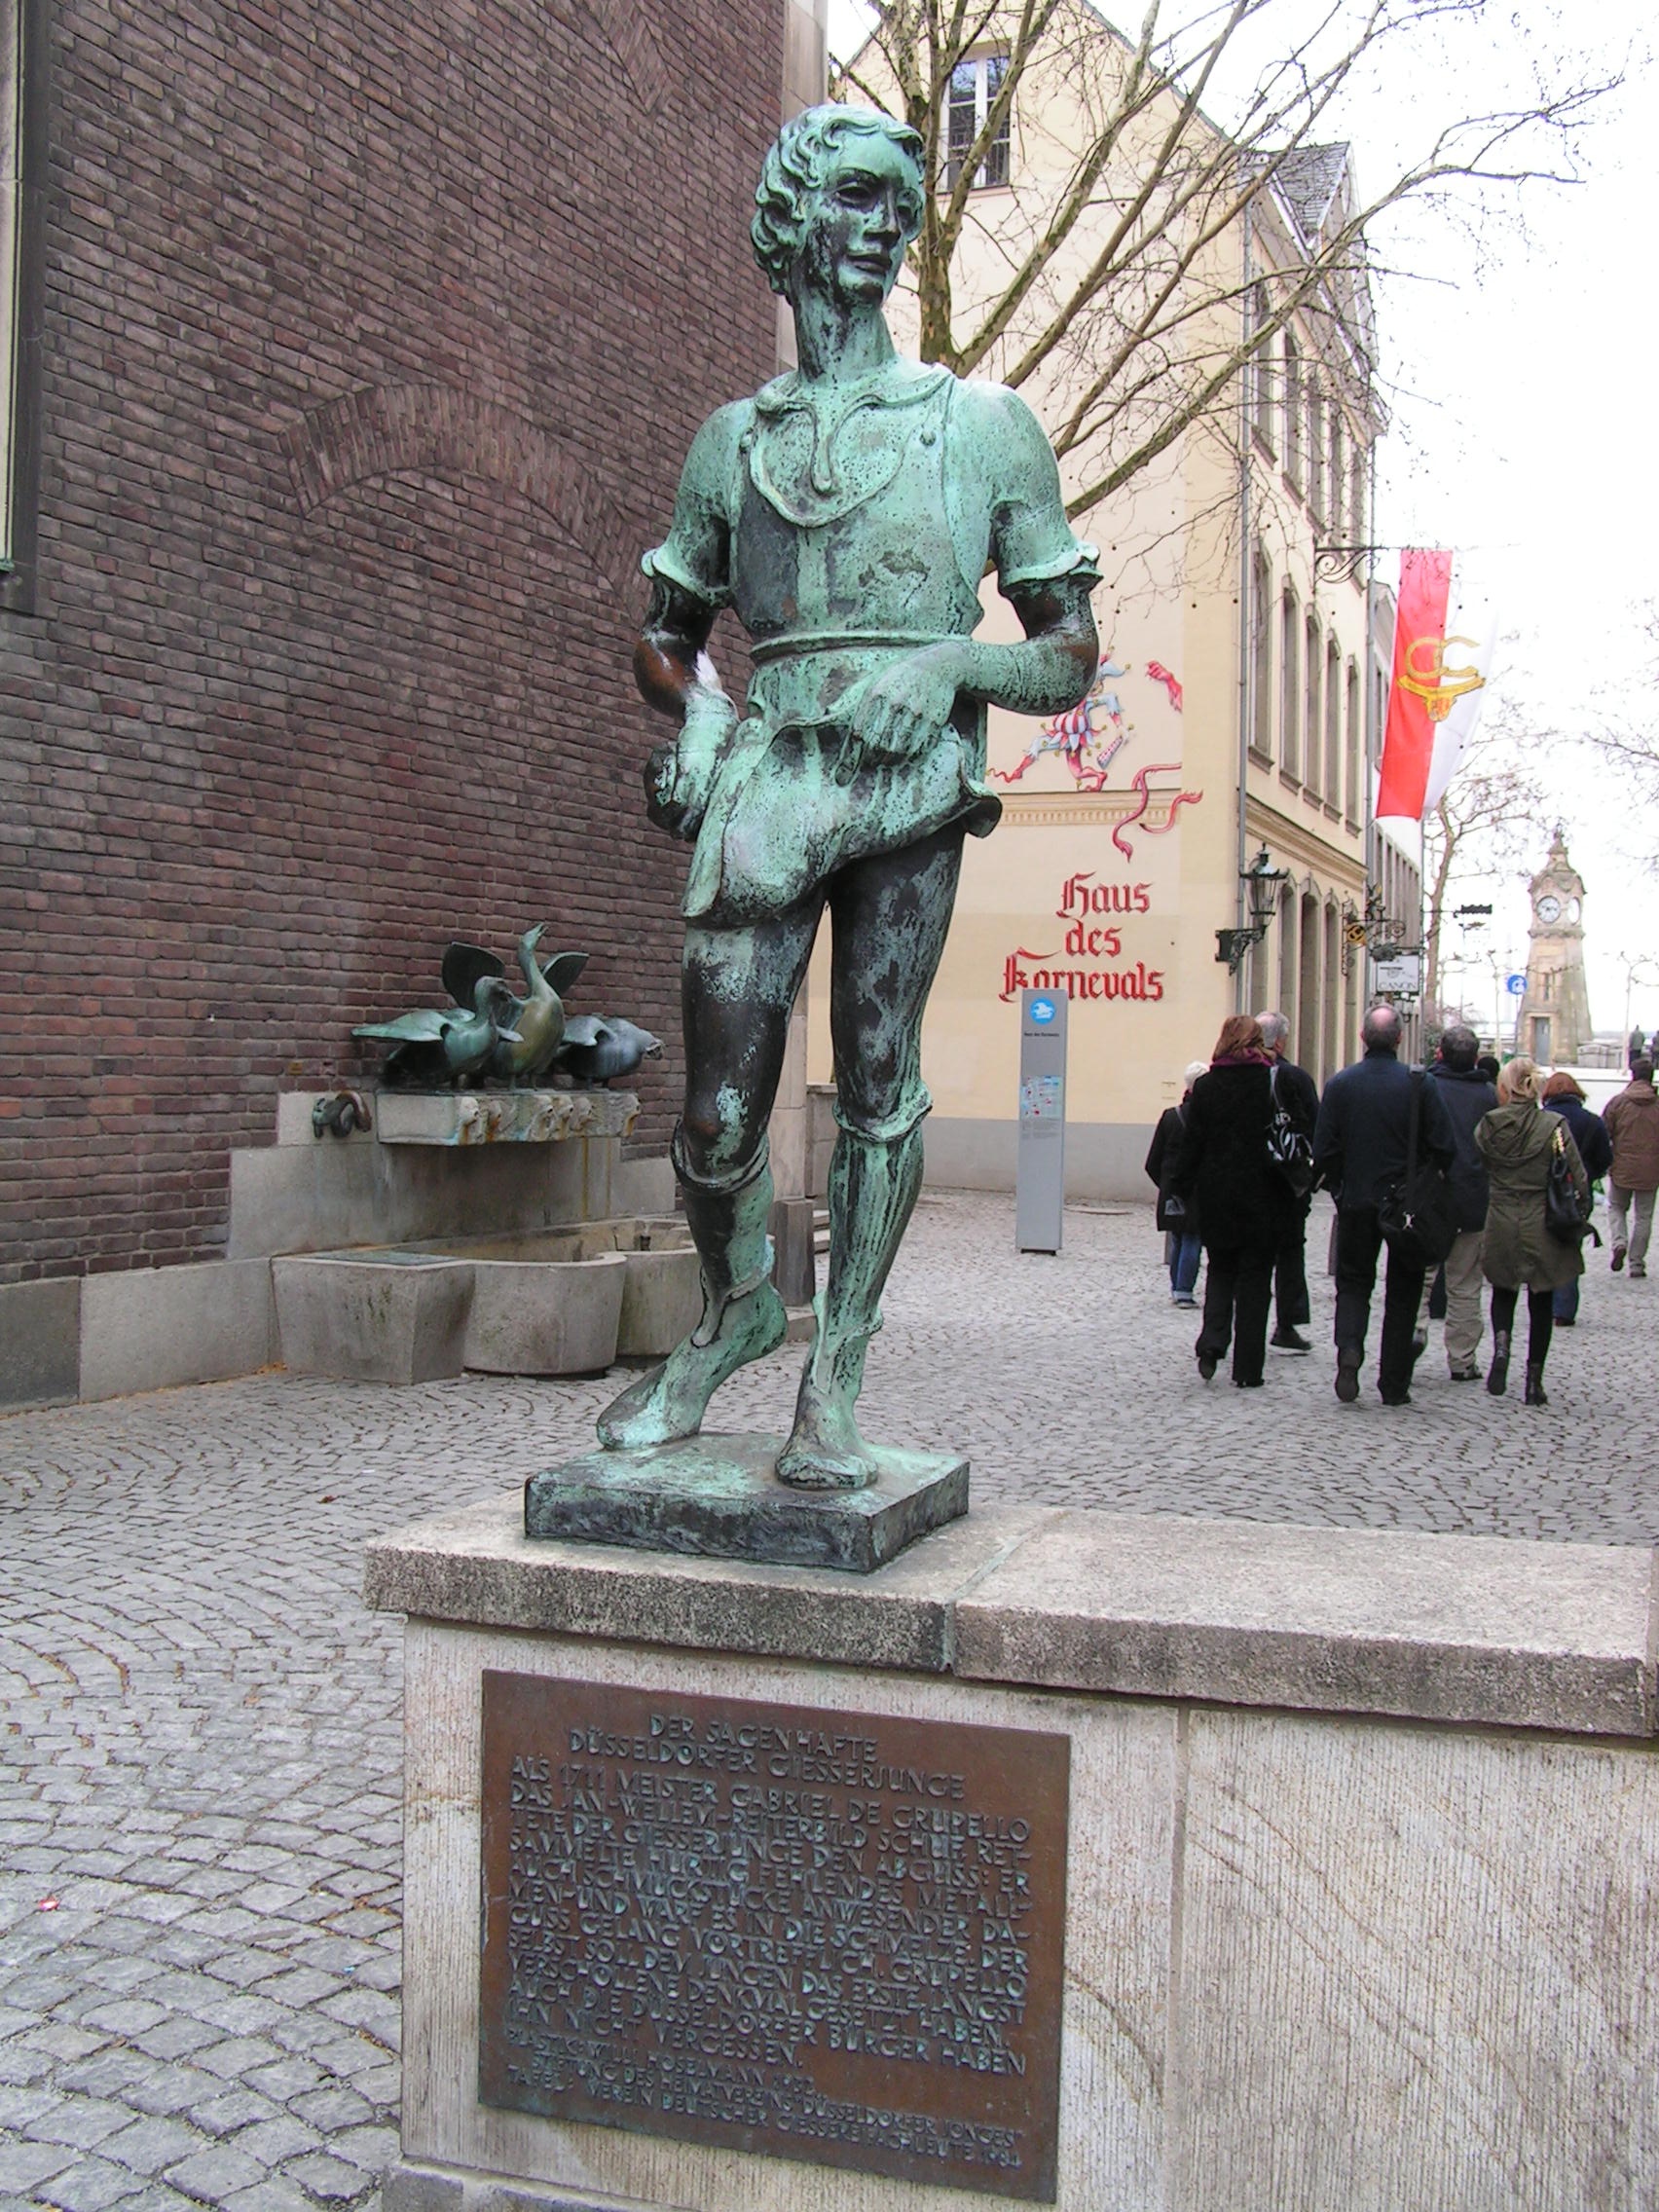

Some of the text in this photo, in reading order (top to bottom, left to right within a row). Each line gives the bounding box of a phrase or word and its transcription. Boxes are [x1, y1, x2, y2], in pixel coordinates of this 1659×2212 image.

[1055, 870, 1153, 918] Haus
[998, 946, 1165, 1003] Karnevals
[1064, 918, 1123, 958] des
[1379, 981, 1417, 990] CANON
[570, 1723, 964, 1799] DÜSSELDORFER GIESSERJUNGE
[650, 1714, 877, 1763] DER SAGENHAFTE
[511, 1756, 1030, 1846] ALS 1711 MEISTER GABRIEL DE GRUPELLO
[511, 1781, 552, 1808] DAS
[977, 1839, 1032, 1870] RET-
[509, 1804, 566, 1835] TETE
[573, 1813, 616, 1841] DER
[623, 1819, 804, 1866] GIESSERJUNGE
[811, 1843, 864, 1874] DEN
[1000, 1867, 1031, 1897] ER
[509, 1829, 636, 1868] SAMMELTE
[647, 1847, 749, 1883] HURTIG
[759, 1862, 903, 1904] FEHLENDES
[510, 1853, 1030, 1947] AUCH SCHMUCKSTÜCKE ANWESENDER DA-
[637, 1895, 703, 1927] WARF
[712, 1905, 737, 1933] ES
[747, 1910, 774, 1937] IN
[784, 1915, 826, 1945] DIE
[980, 1943, 1029, 1973] DER
[508, 1925, 580, 1959] SELBST
[583, 1936, 640, 1968] SOLL
[644, 1945, 691, 1975] DEM
[698, 1953, 793, 1990] JUNGEN
[801, 1969, 842, 1998] DAS
[510, 1901, 570, 1932] GUSS
[579, 1911, 681, 1948] GELANG
[891, 1956, 1026, 1999] GRUPELLO
[507, 1949, 679, 1998] VERSCHOLLENE
[687, 1976, 803, 2017] DENKMAL
[807, 1995, 910, 2034] GESETZT
[507, 1999, 552, 2027] IHN
[565, 2008, 642, 2042] NICHT
[509, 1974, 1026, 2078] AUCH DIE DÜSSELDORFER BÜRGER HABEN
[587, 2078, 652, 2108] VEREIN
[662, 2090, 767, 2127] DEUTSCHER
[623, 2065, 655, 2088] DES
